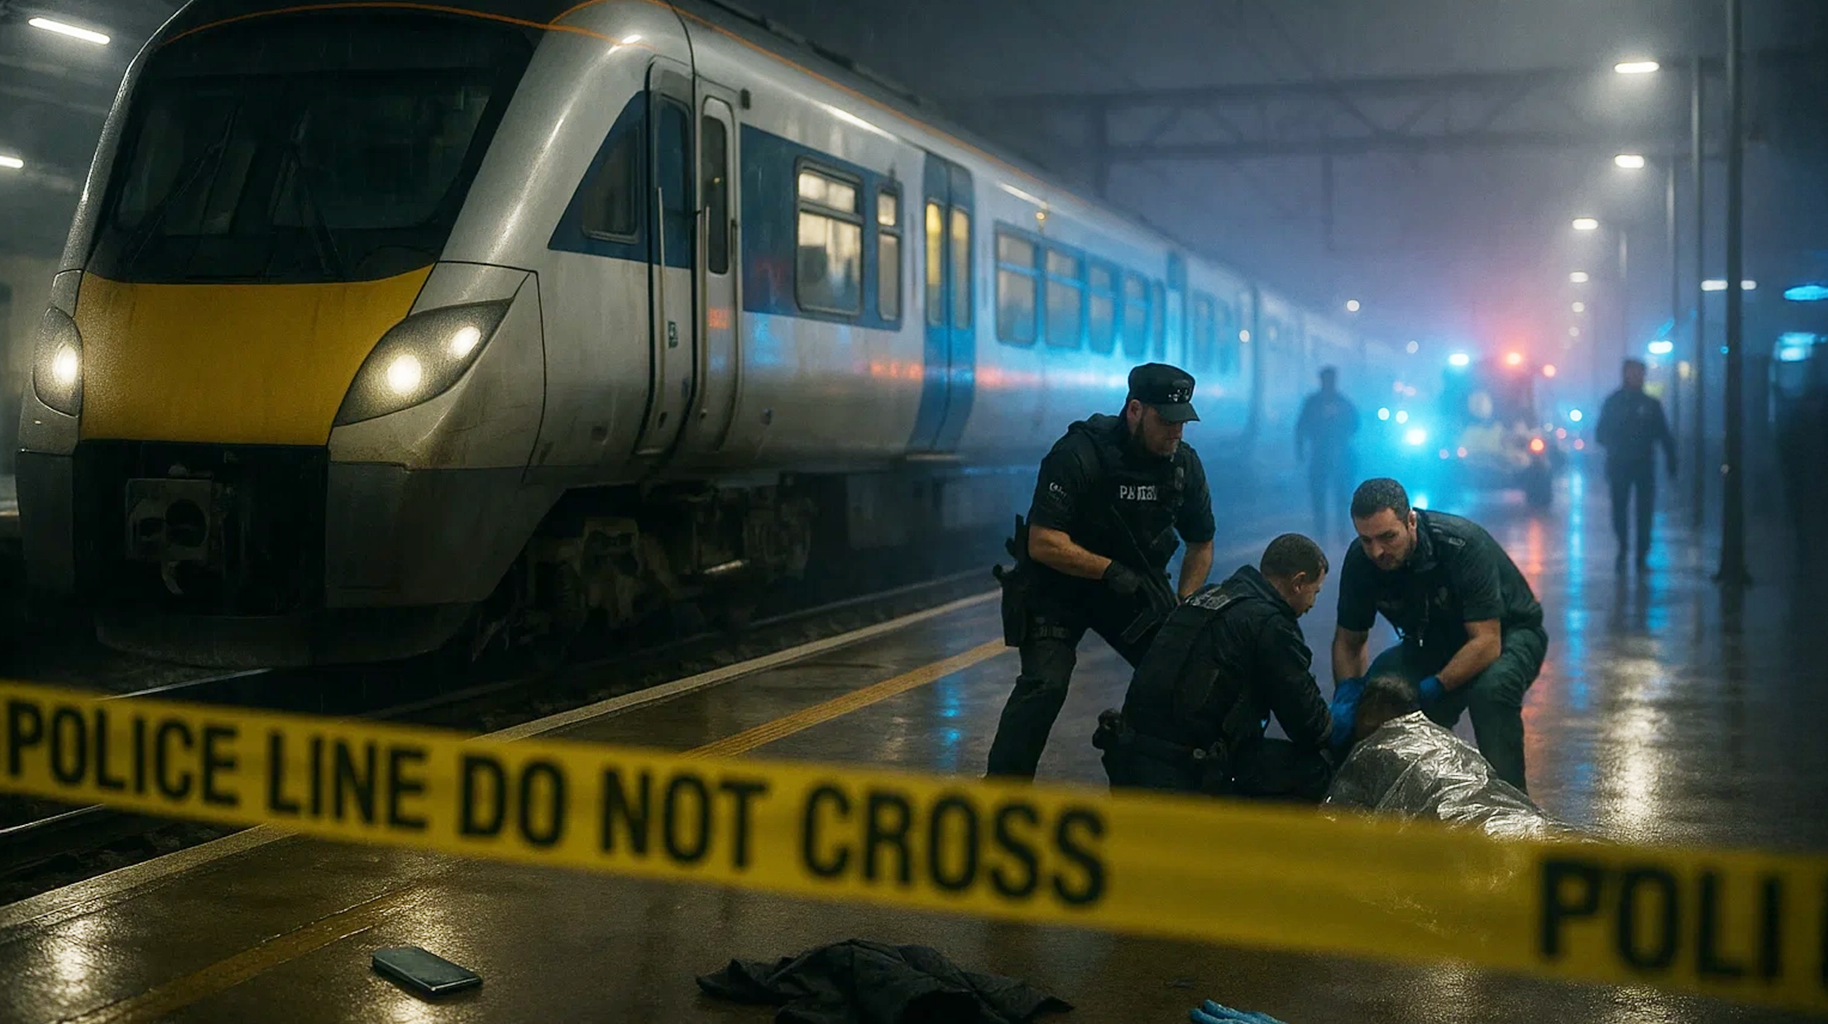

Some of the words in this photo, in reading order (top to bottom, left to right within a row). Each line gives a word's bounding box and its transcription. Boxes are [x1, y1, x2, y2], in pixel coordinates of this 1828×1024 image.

[8, 700, 239, 806] POLICE
[267, 727, 430, 832] LINE
[457, 751, 568, 848] DO
[601, 766, 769, 871] NOT
[801, 782, 1107, 907] CROSS
[1540, 857, 1828, 985] POLI
